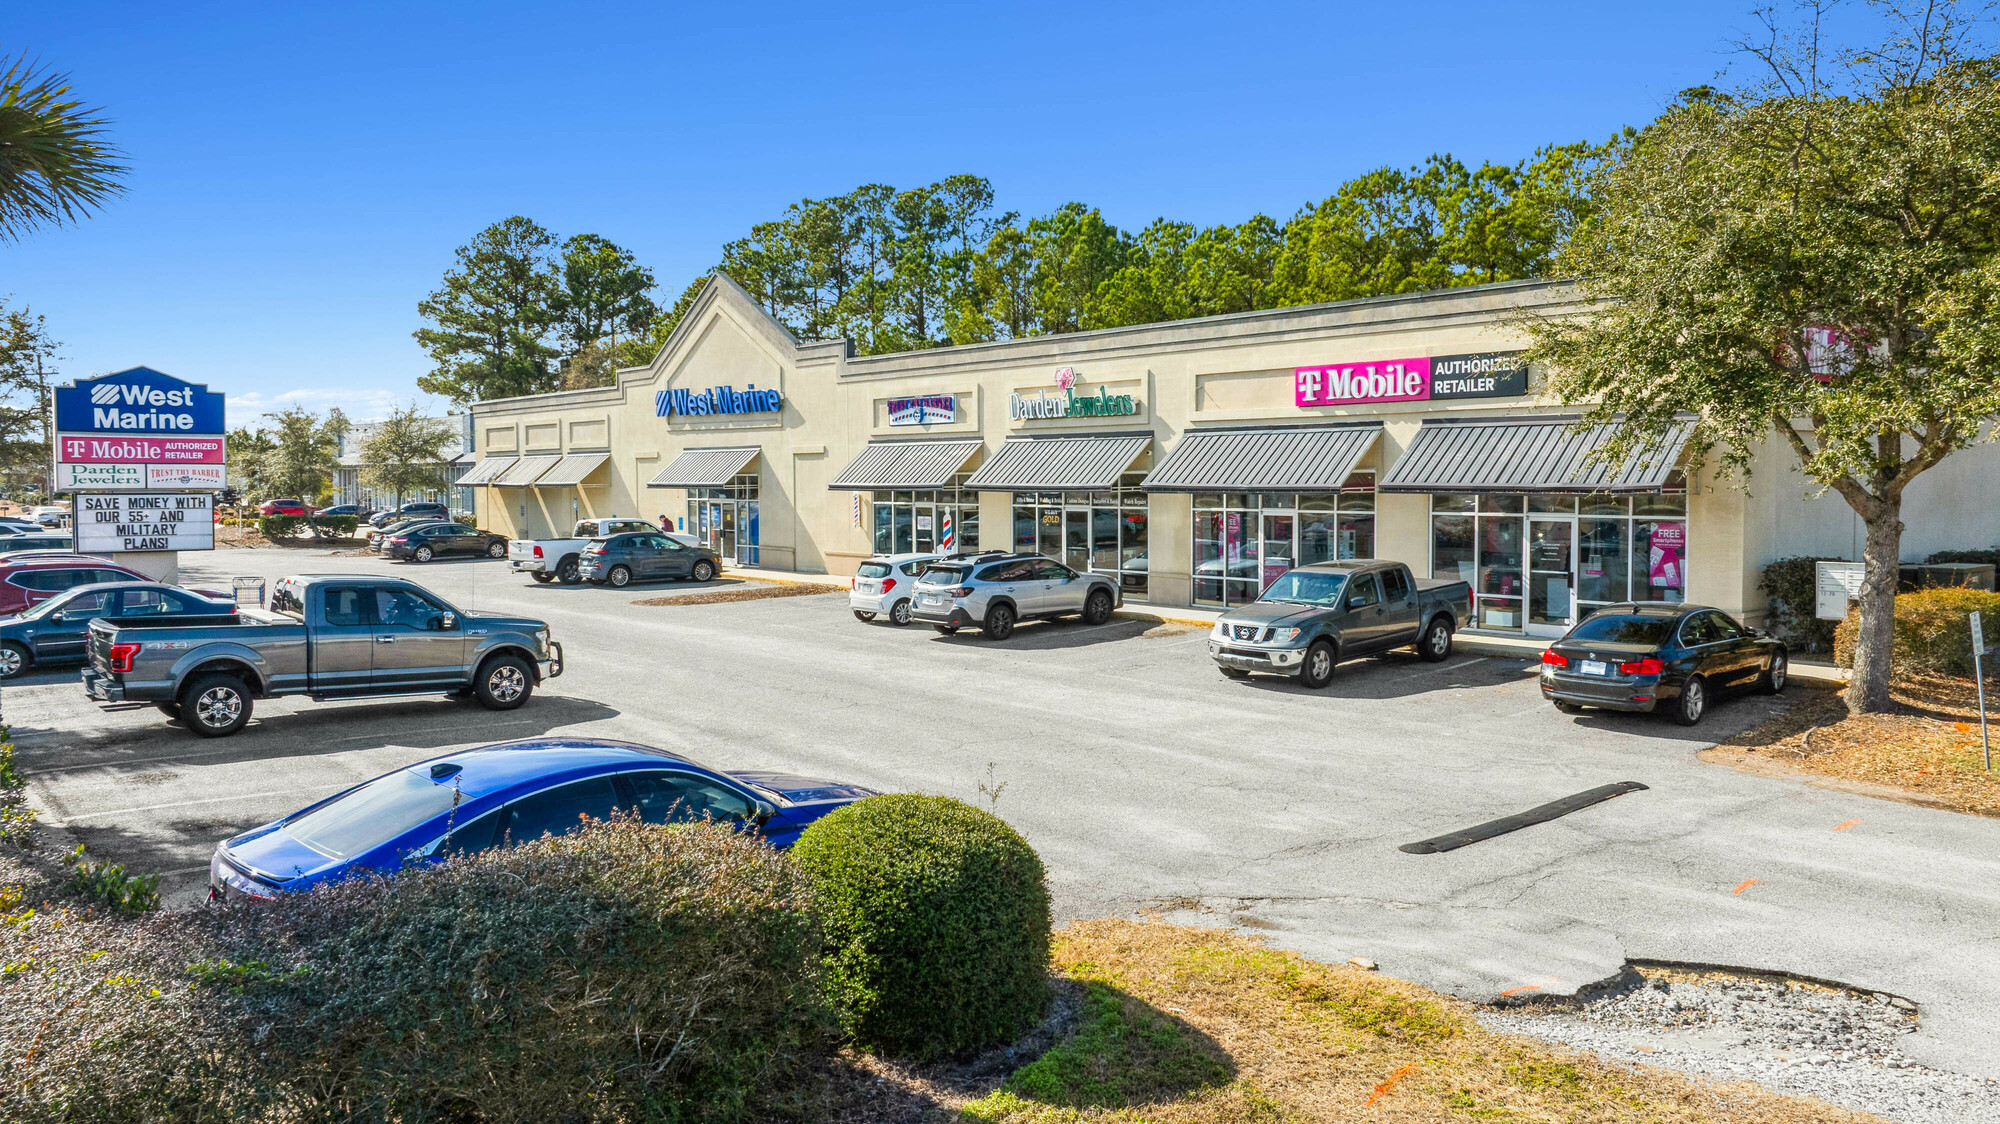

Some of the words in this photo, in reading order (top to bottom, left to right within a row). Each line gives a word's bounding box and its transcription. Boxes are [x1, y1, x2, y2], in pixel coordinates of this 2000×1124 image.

[1326, 364, 1424, 400] Mobile
[1435, 377, 1495, 394] RETAILER
[120, 384, 193, 406] West
[672, 387, 716, 416] West
[715, 384, 780, 415] Marine
[1008, 389, 1067, 420] Darden
[1066, 385, 1135, 418] Jewelers
[93, 408, 194, 430] Marine
[91, 441, 161, 459] Mobile
[165, 442, 218, 451] AUTHORIZED
[165, 451, 203, 459] RETAILER
[71, 464, 138, 475] Darden
[192, 469, 220, 478] BARBER
[69, 474, 141, 486] Jewelers
[85, 498, 120, 509] SAVE
[128, 497, 169, 509] MONEY
[175, 497, 206, 508] WITH
[96, 511, 120, 523] OUR
[128, 511, 150, 522] 55+
[159, 511, 184, 522] AND
[1042, 515, 1060, 523] GOLD
[116, 524, 177, 536] MILITARY
[1658, 529, 1680, 538] FREE
[124, 537, 168, 550] PLANS!
